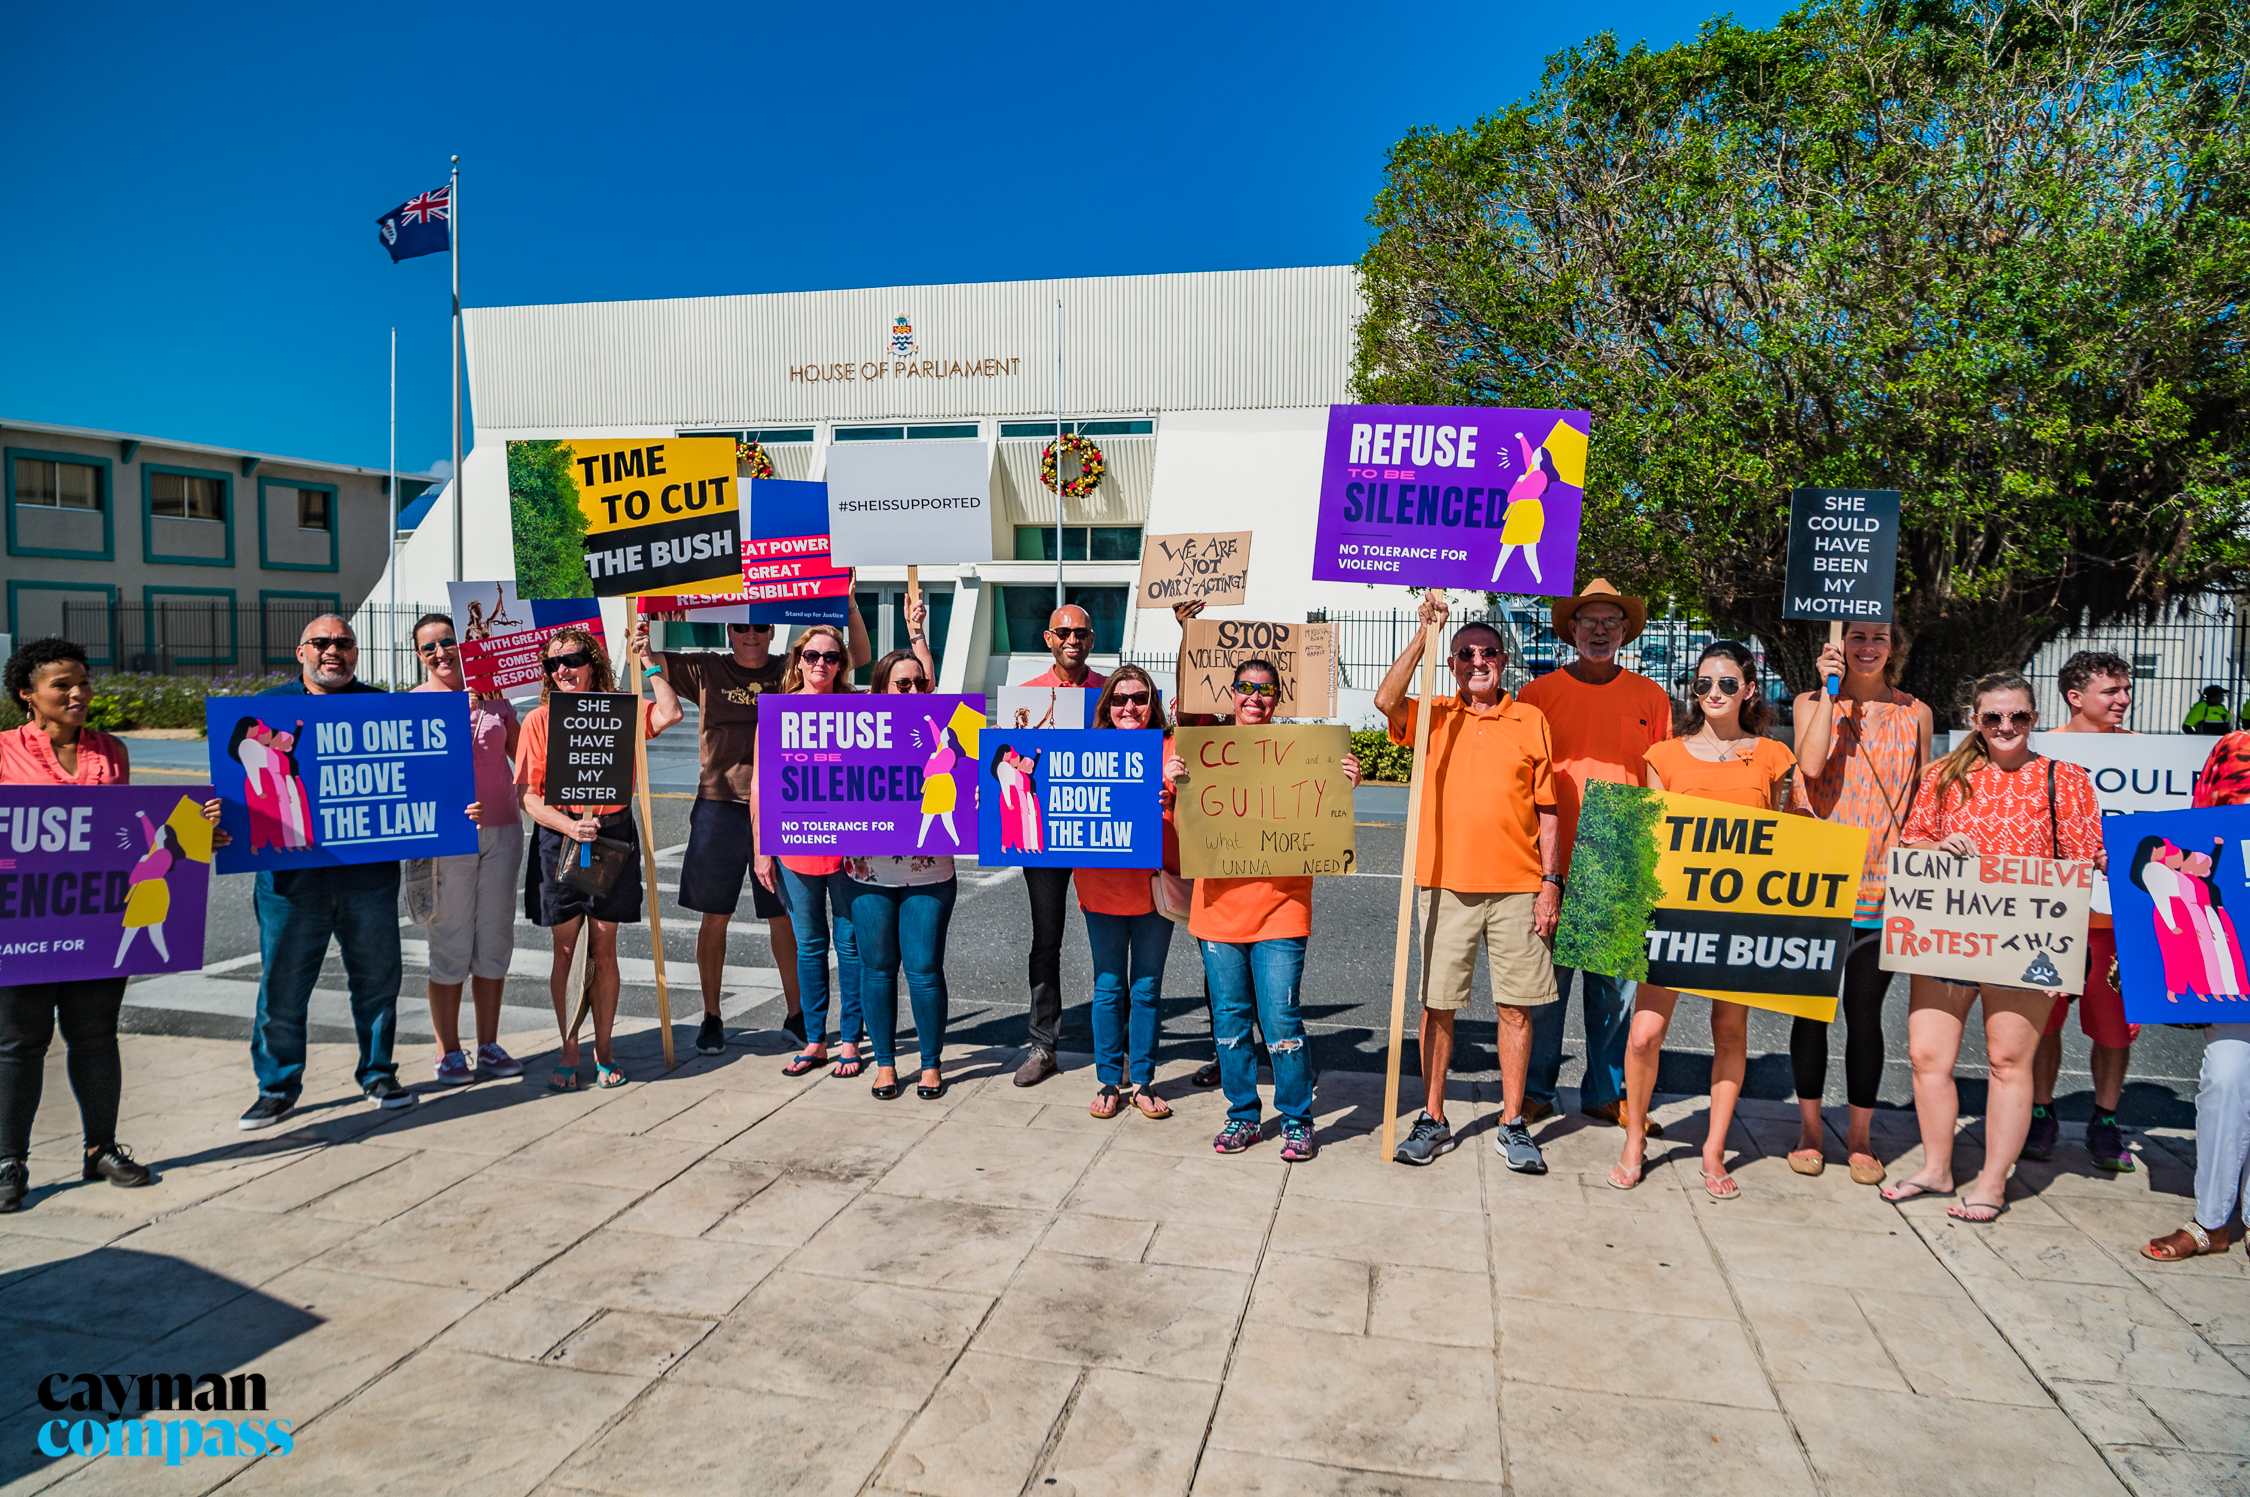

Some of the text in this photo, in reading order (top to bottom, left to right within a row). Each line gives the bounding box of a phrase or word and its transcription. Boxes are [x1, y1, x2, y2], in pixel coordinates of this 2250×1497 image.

[790, 357, 1020, 382] HOUSE OF PARLIAMENT
[1349, 423, 1478, 468] REFUSE
[577, 444, 666, 487] TIME
[1347, 468, 1416, 481] TO BE
[600, 476, 729, 524] TO CUT
[838, 497, 981, 512] #SHEISSUPPORTED
[1343, 482, 1508, 529] SILENCED
[1824, 496, 1865, 512] SHE
[1808, 516, 1880, 532] COULD
[584, 529, 733, 579] THE BUSH
[740, 538, 829, 558] EAT POWER
[1158, 537, 1238, 561] WE ARE
[1339, 543, 1467, 561] NO TOLERANCE FOR
[1815, 536, 1870, 553] HAVE
[748, 563, 802, 581] GREAT
[1176, 558, 1222, 577] NOT
[1338, 558, 1400, 572] VIOLENCE
[1813, 557, 1868, 574] BEEN
[677, 581, 822, 606] RESPONSIBILITY
[1824, 578, 1856, 593] MY
[785, 610, 803, 618] Stand
[822, 611, 844, 619] Justice
[1794, 597, 1882, 616] MOTHER
[479, 638, 511, 652] WITH
[513, 630, 549, 646] GREAT
[1217, 620, 1290, 650] STOP
[498, 652, 538, 669] COMES
[1188, 649, 1245, 670] VIOLENCE
[493, 666, 544, 687] RESPON
[577, 699, 610, 712] SHE
[563, 717, 622, 730] COULD
[781, 711, 892, 749] REFUSE
[316, 718, 447, 754] NO ONE IS
[570, 735, 614, 747] HAVE
[569, 752, 613, 765] BEEN
[781, 753, 842, 762] TO BE
[1200, 740, 1239, 768] CC
[1254, 739, 1295, 766] TV
[1305, 754, 1320, 765] and
[1049, 751, 1144, 778] NO ONE IS
[319, 761, 406, 797] ABOVE
[578, 770, 603, 782] MY
[781, 765, 924, 802] SILENCED
[2083, 767, 2206, 796] OUL
[561, 787, 616, 799] SISTER
[1048, 786, 1111, 812] ABOVE
[320, 801, 436, 839] THE LAW
[1331, 810, 1347, 818] PLEA
[781, 821, 895, 832] NO TOLERANCE FOR
[1048, 820, 1133, 847] THE LAW
[1665, 815, 1778, 856] TIME
[781, 834, 837, 845] VIOLENCE
[1261, 830, 1314, 853] MORE
[1222, 859, 1271, 875] UNNA
[1892, 851, 2093, 888] I CANT BELIEVE
[1683, 867, 1850, 909] TO CUT
[1889, 886, 2068, 919] WE HAVE TO
[53, 939, 86, 952] FOR
[1646, 930, 1837, 971] THE BUSH
[2000, 932, 2074, 954] THIS
